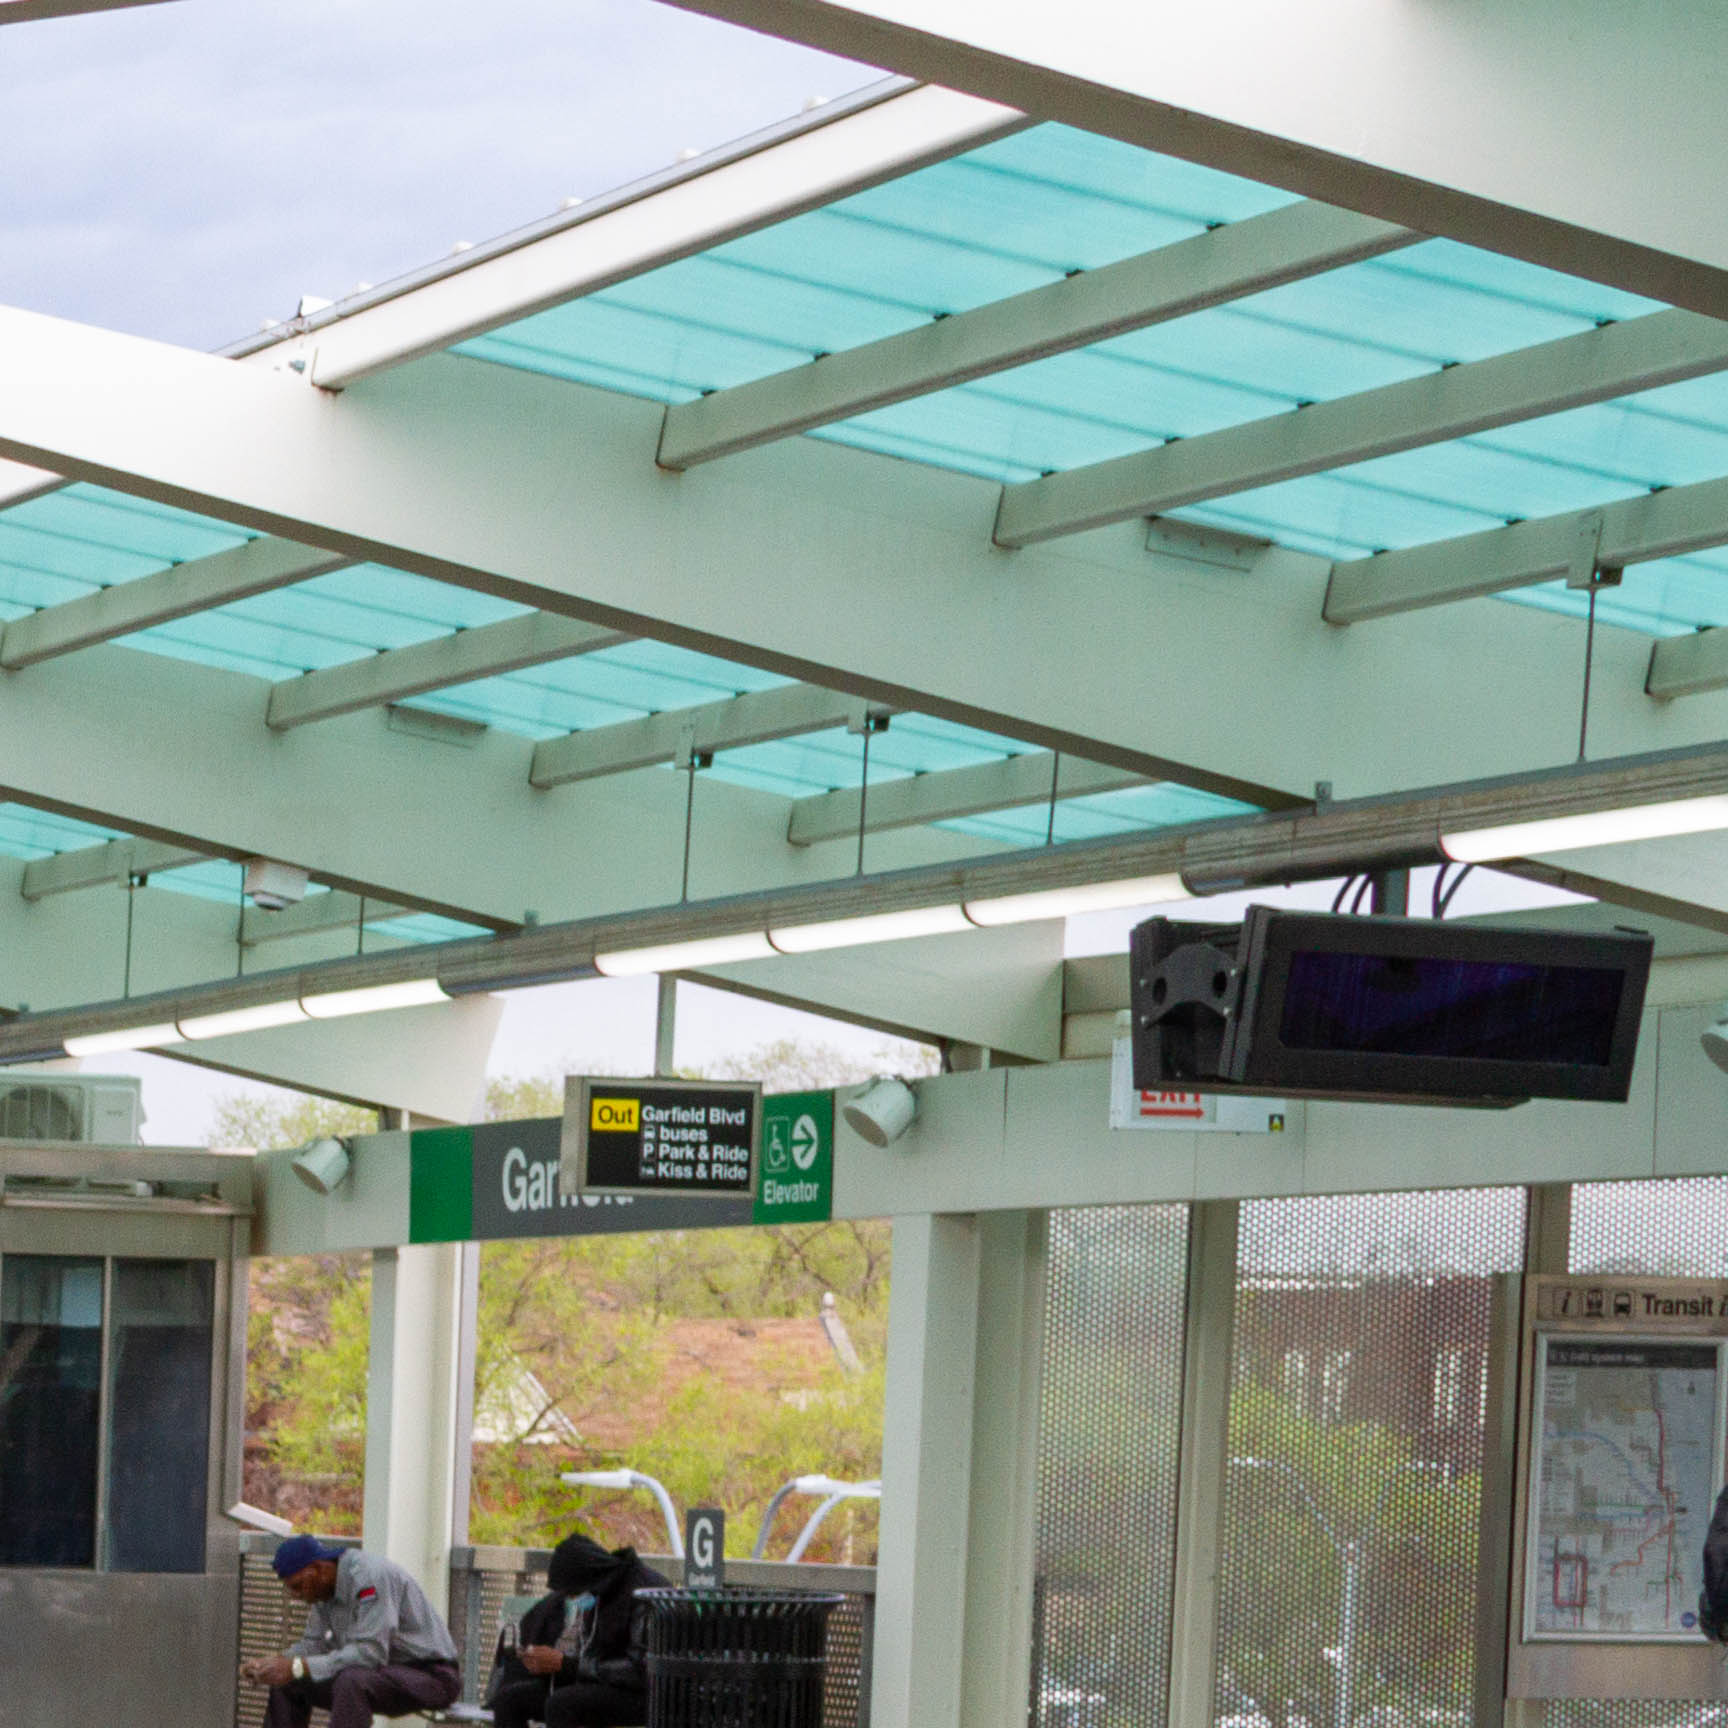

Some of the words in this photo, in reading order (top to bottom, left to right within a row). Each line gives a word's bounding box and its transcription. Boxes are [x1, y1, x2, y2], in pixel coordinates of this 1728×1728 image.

[598, 1105, 633, 1124] Out
[641, 1105, 705, 1124] Garfield
[709, 1108, 745, 1125] Blvd
[660, 1125, 708, 1142] buses
[659, 1143, 694, 1161] Park
[697, 1145, 709, 1161] &
[713, 1144, 748, 1162] Ride
[658, 1162, 692, 1178] Kiss
[696, 1164, 708, 1179] &
[711, 1163, 748, 1180] Ride
[764, 1179, 819, 1204] Elevator
[1642, 1293, 1713, 1316] Transit
[692, 1517, 714, 1569] G
